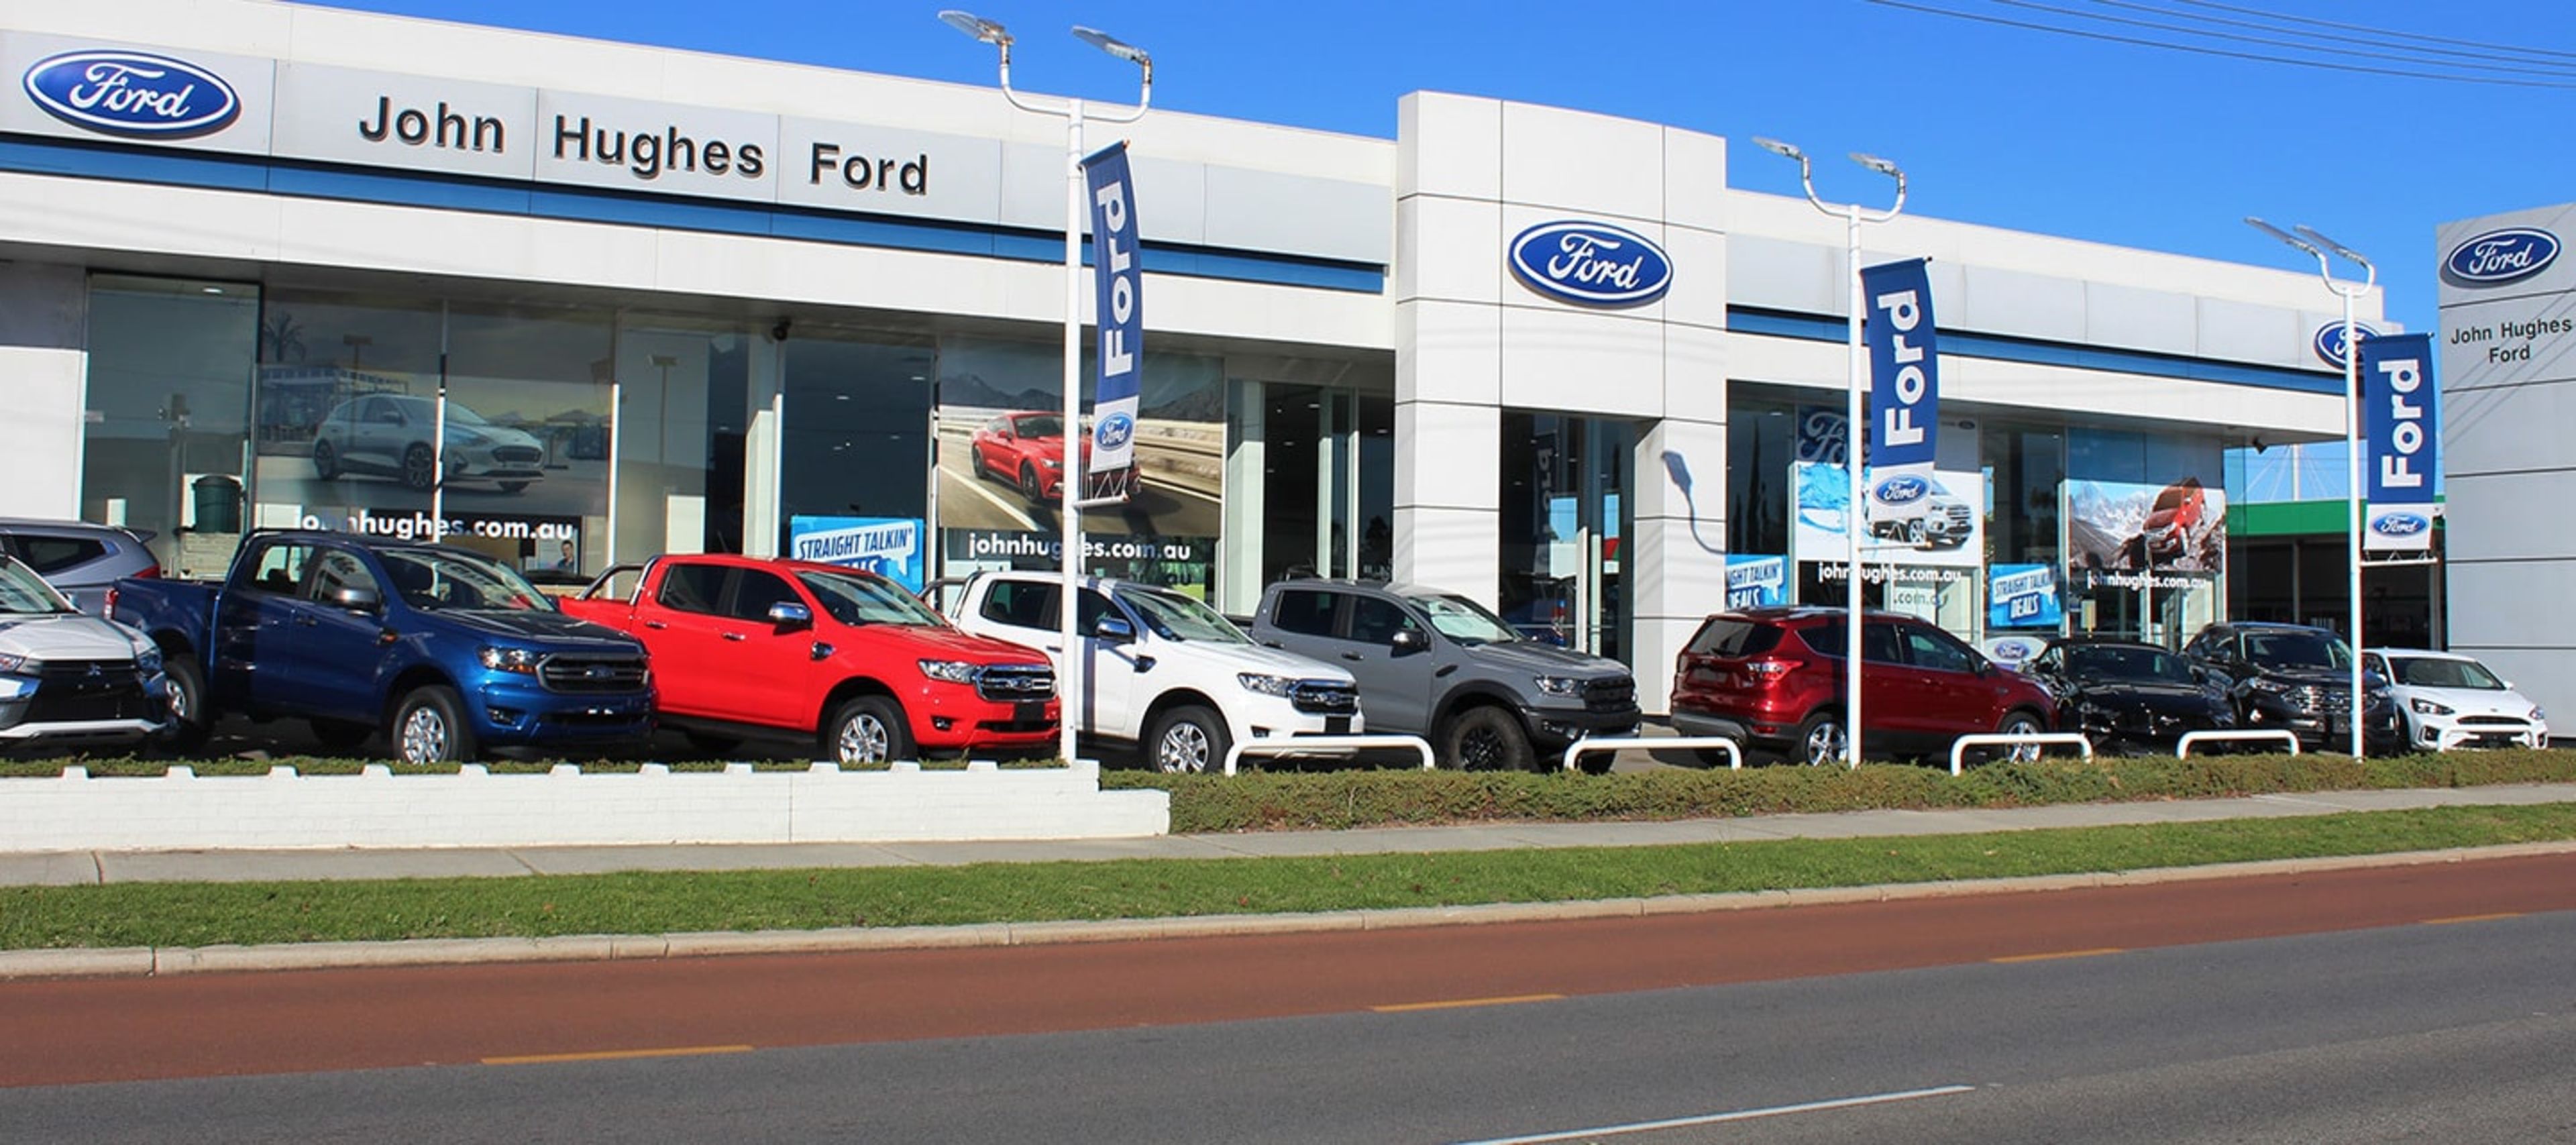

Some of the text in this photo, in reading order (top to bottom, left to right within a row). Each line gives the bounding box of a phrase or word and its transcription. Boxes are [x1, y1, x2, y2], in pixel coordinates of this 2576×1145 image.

[68, 61, 195, 119] Ford
[359, 96, 928, 195] John Hughes Ford
[1547, 232, 1643, 289] Ford
[2469, 238, 2534, 274] Ford
[1097, 181, 1133, 377] Ford
[2451, 319, 2573, 344] John Hughes
[2489, 345, 2530, 363] Ford
[1878, 290, 1926, 447] Ford
[1102, 420, 1128, 445] Ford
[2378, 359, 2423, 487] Ford
[1884, 479, 1920, 502] Ford
[296, 508, 573, 539] onhughes.com.au
[2381, 514, 2418, 533] Ford
[799, 534, 861, 560] STRAIGHT
[969, 532, 1190, 560] johnhuges.com.au
[1818, 561, 1961, 584] johnughes.com.au
[2010, 594, 2039, 619] DEALS
